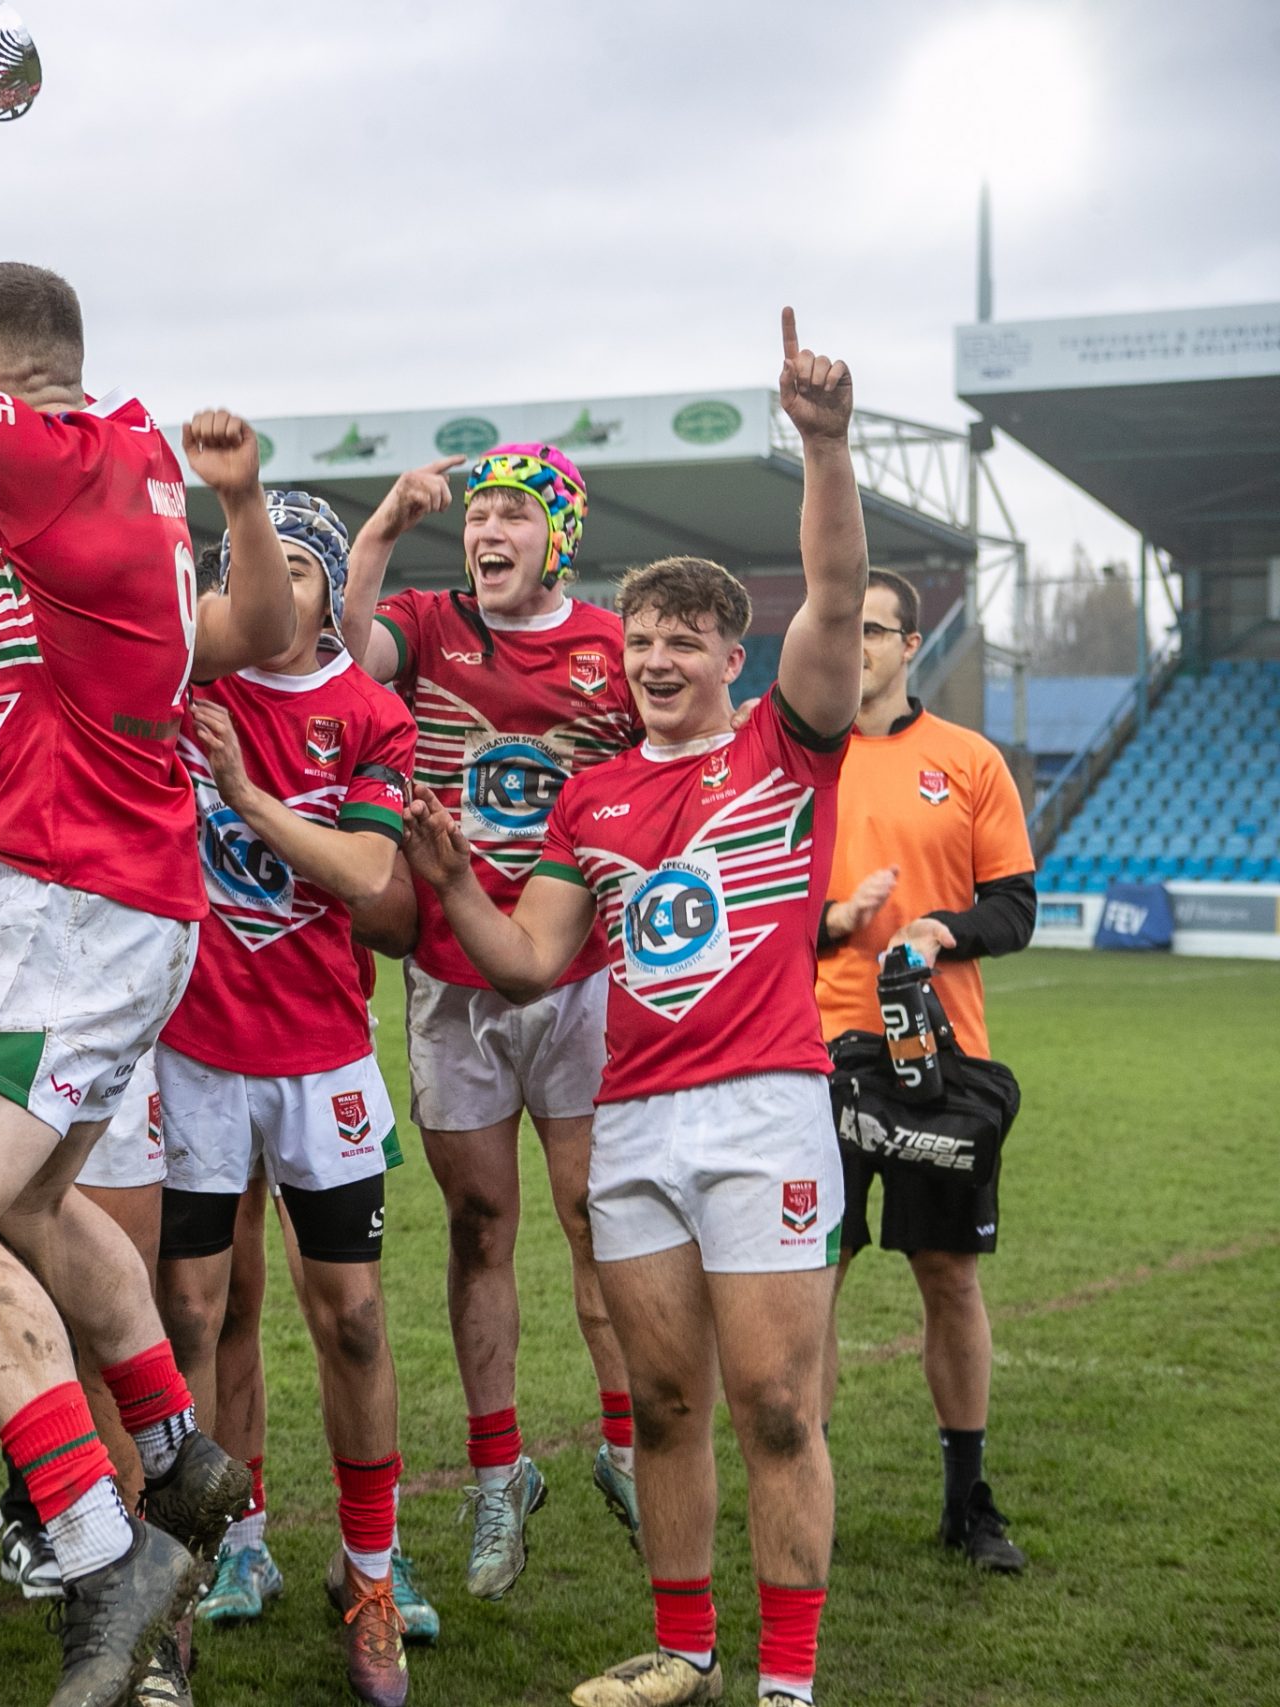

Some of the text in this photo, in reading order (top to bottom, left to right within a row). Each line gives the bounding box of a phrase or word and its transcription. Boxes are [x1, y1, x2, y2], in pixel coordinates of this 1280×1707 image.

[174, 541, 197, 706] 9
[441, 647, 482, 665] VX3
[315, 719, 339, 729] WALES
[472, 735, 564, 766] INSULATION SPECIALISTS
[464, 800, 501, 834] INDUSTRIAL
[592, 803, 630, 821] VX3
[662, 861, 710, 881] SPECIALISTS
[627, 887, 715, 954] K&G
[664, 953, 705, 975] ACOUSTIC
[707, 928, 726, 951] HVAC
[51, 1073, 82, 1106] VX3
[338, 1094, 358, 1103] WALES
[341, 1149, 355, 1158] WALES
[364, 1145, 375, 1155] 2024
